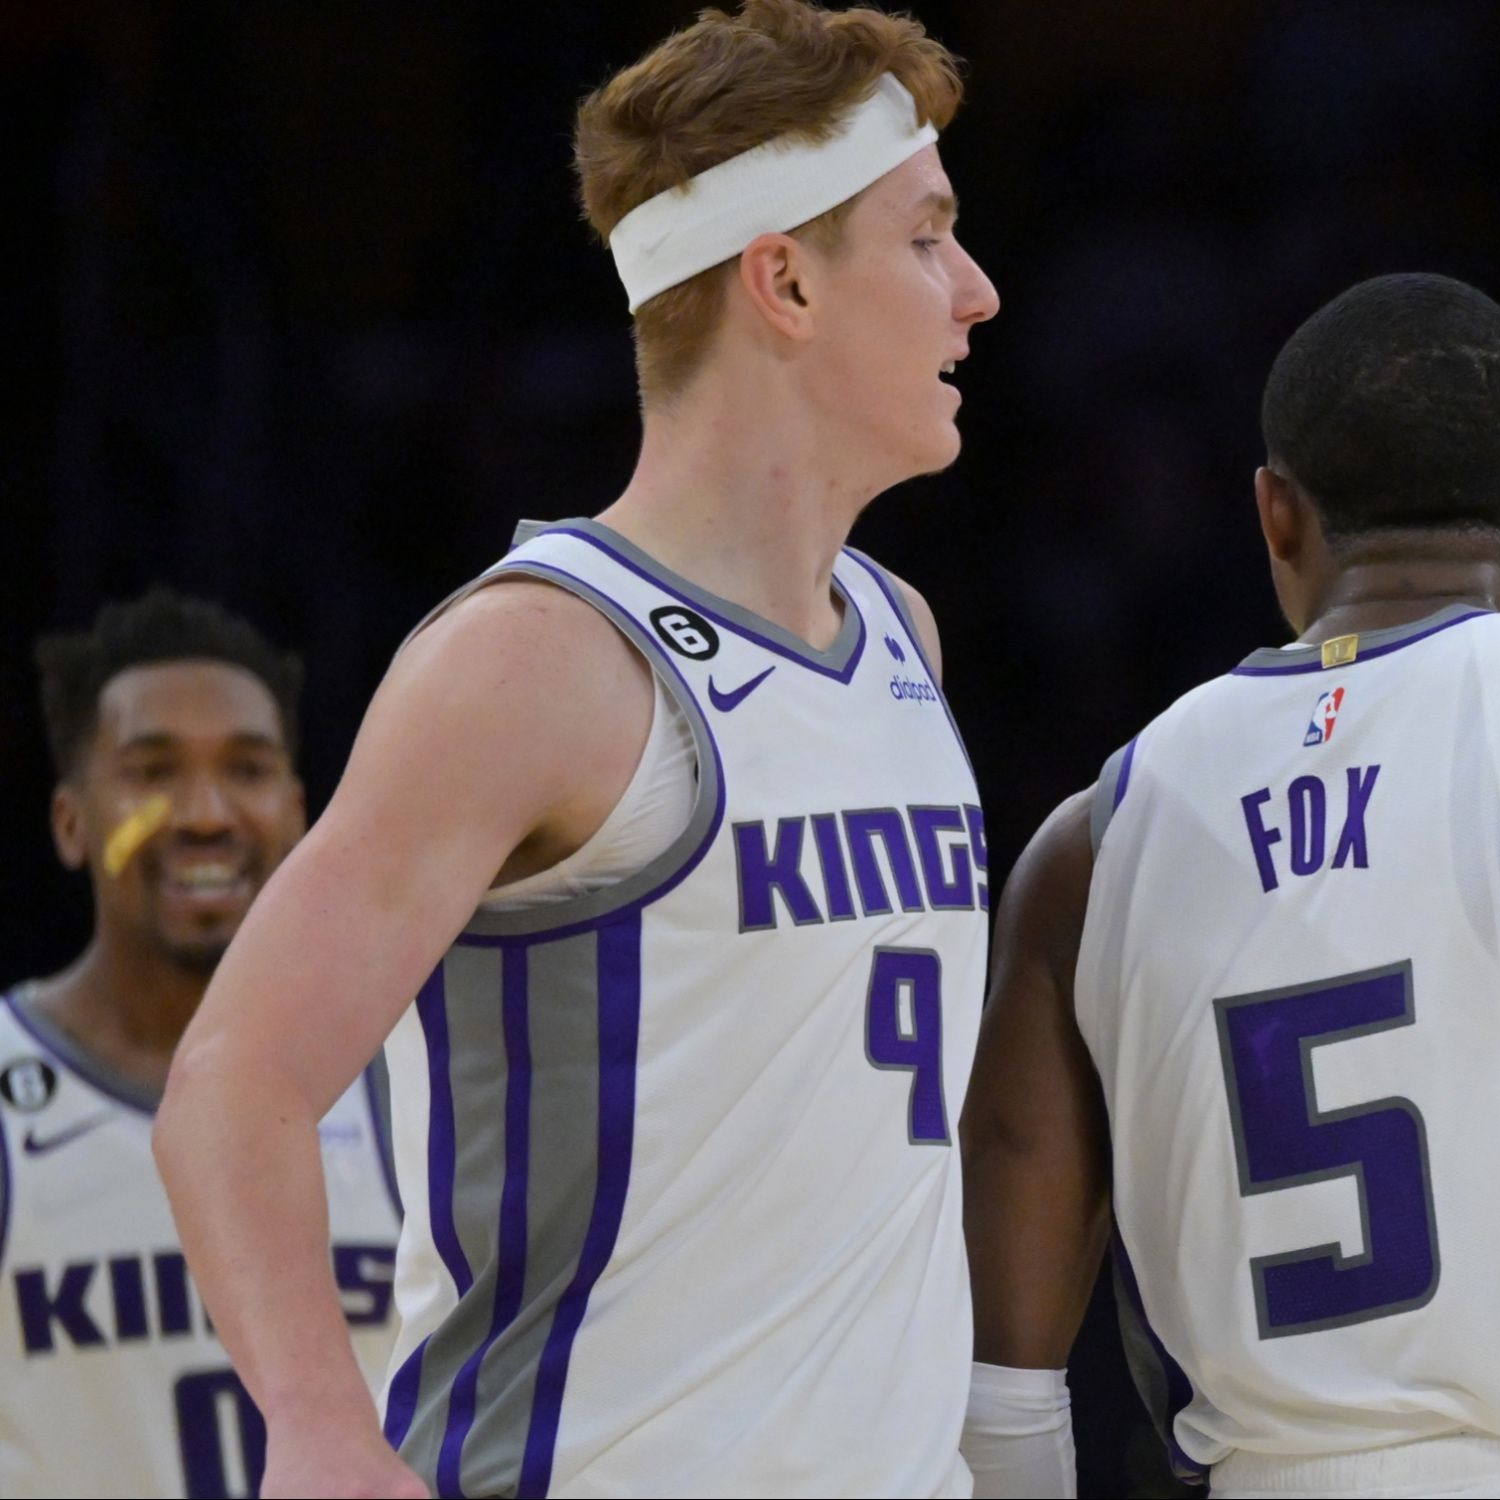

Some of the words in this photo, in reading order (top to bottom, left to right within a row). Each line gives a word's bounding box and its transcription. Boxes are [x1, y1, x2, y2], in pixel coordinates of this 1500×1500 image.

[659, 612, 709, 654] 6
[890, 675, 937, 706] dialpad
[1240, 764, 1381, 893] FOX
[864, 945, 952, 1147] 9
[1212, 958, 1441, 1340] 5
[14, 1244, 399, 1357] KIS
